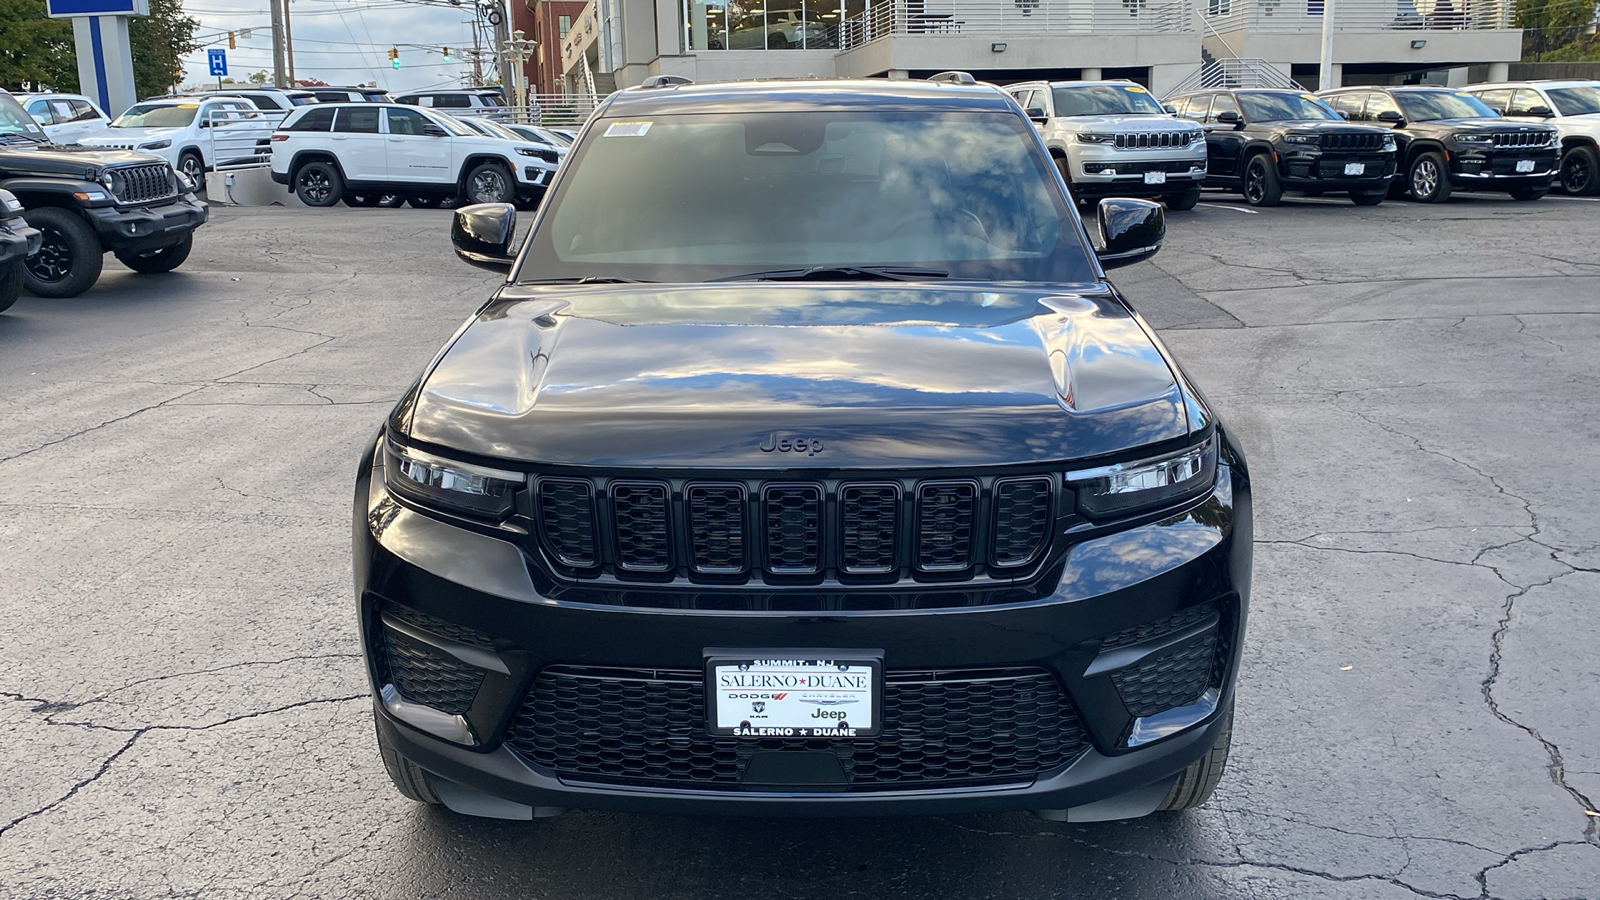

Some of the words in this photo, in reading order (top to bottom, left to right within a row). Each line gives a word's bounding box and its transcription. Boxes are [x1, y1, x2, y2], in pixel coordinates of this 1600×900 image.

[212, 55, 223, 68] H
[759, 433, 824, 457] Jeep
[721, 674, 797, 688] SALERNO
[807, 675, 867, 688] DUANE
[811, 708, 847, 721] Jeep
[733, 727, 794, 737] SALERNO
[813, 728, 857, 737] DUANE
